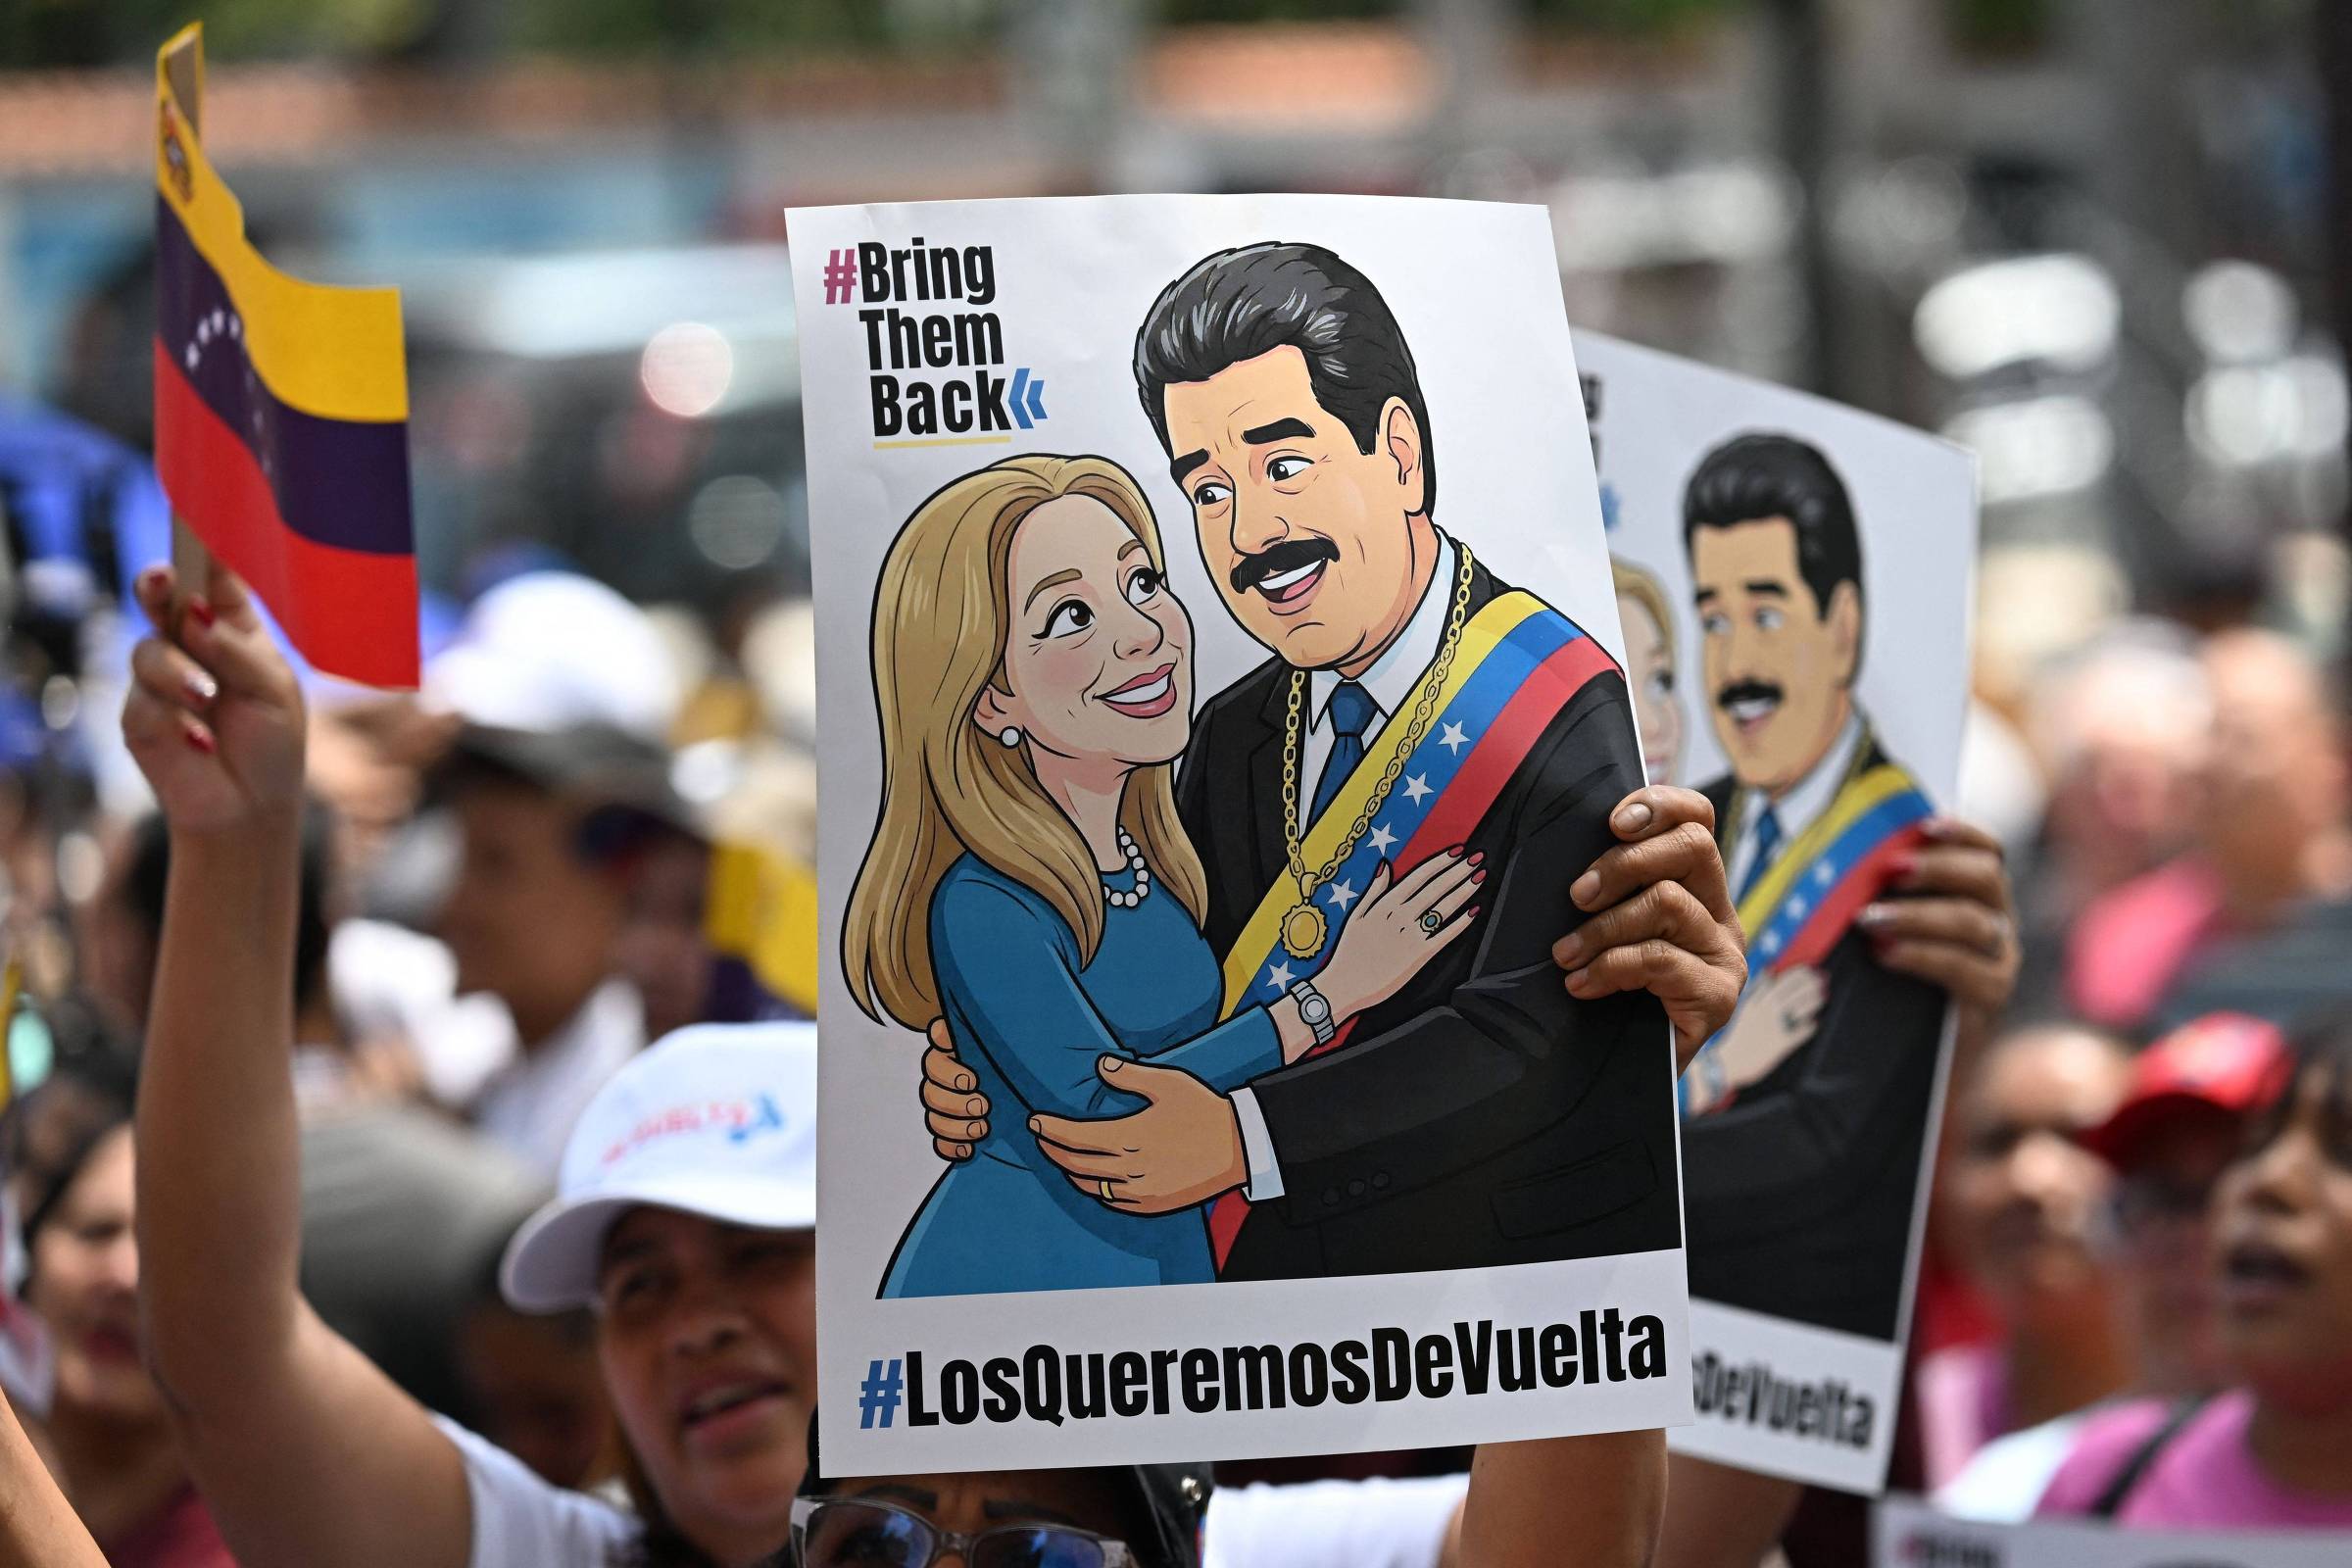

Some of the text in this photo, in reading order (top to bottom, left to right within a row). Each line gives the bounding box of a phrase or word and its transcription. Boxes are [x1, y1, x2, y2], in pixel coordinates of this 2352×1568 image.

[823, 236, 996, 305] #Bring
[858, 308, 1004, 370] Them
[870, 369, 1012, 437] Back
[858, 1307, 1667, 1430] #LosQueremosDeVuelta
